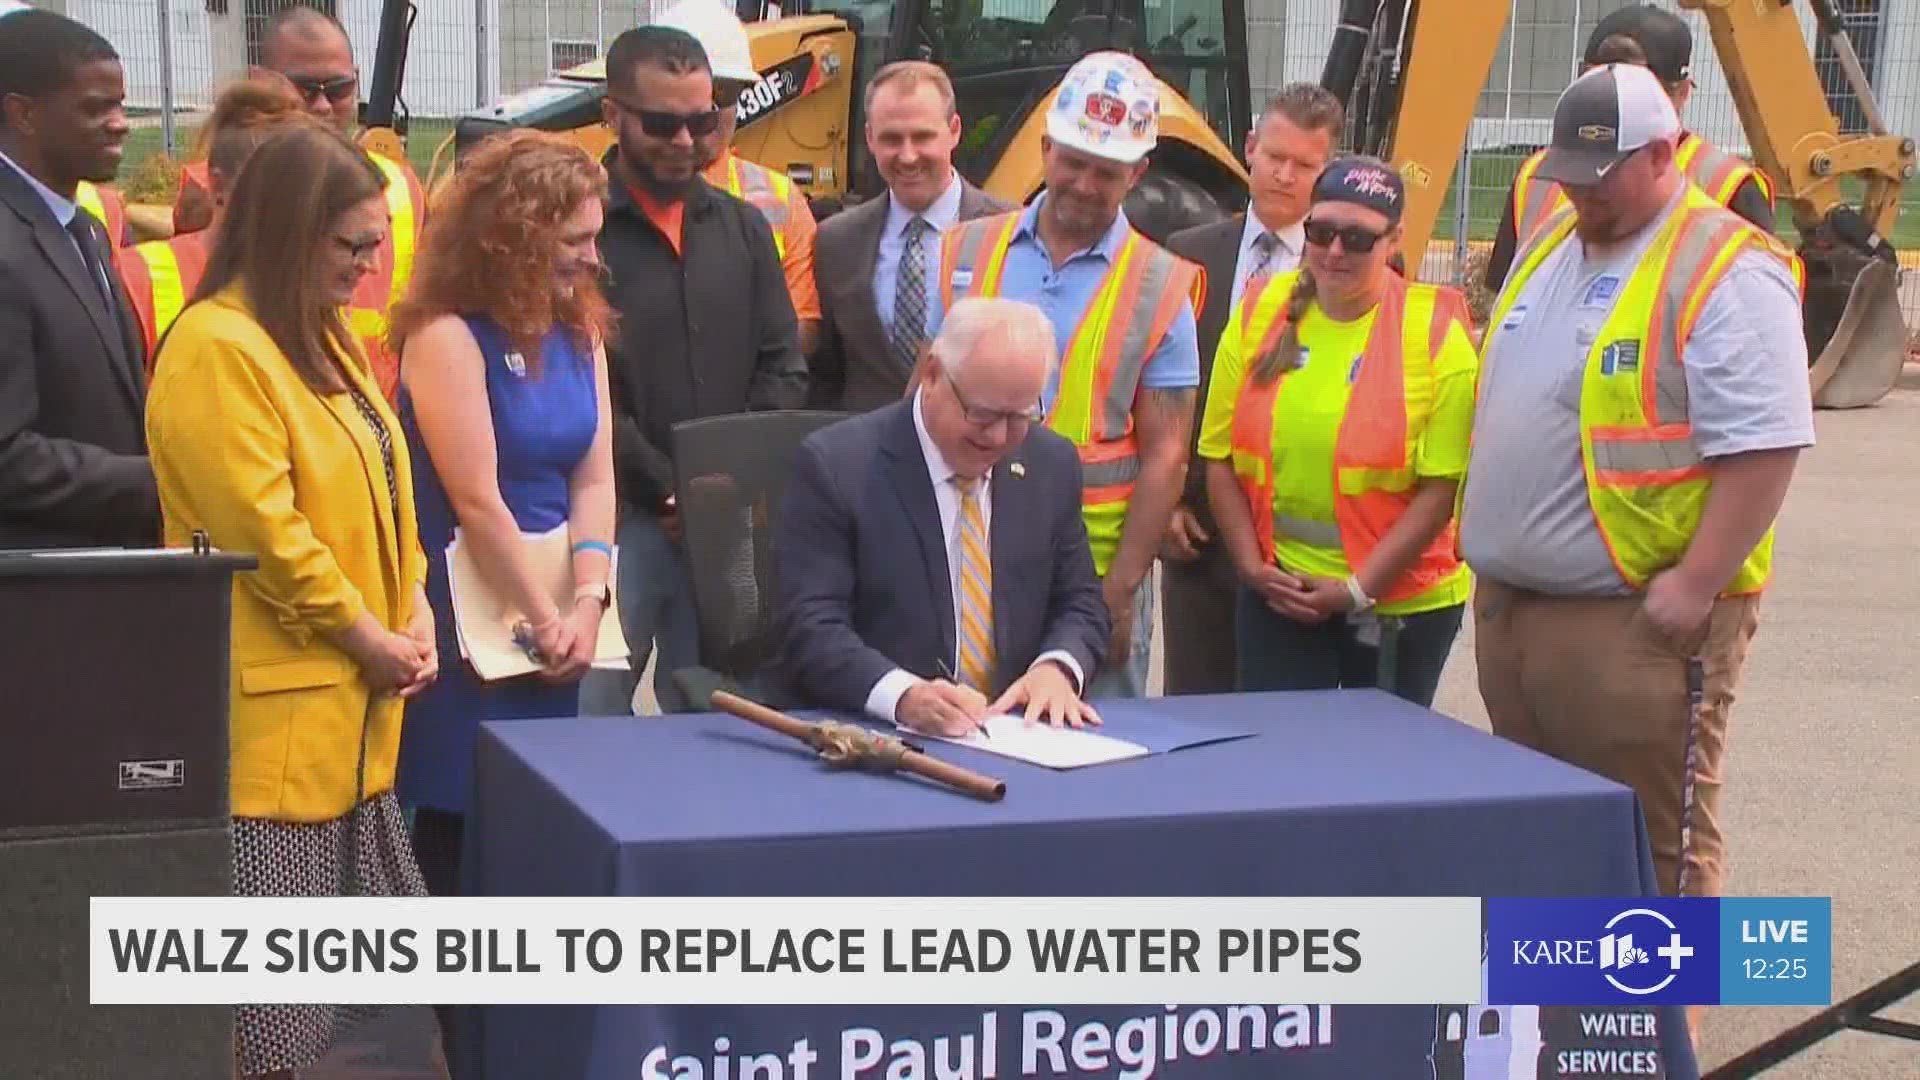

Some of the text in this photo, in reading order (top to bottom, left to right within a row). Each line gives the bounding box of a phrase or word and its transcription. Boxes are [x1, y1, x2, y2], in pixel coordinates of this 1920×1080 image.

[1580, 1013, 1657, 1037] WATER
[841, 1010, 997, 1080] Paul
[1022, 1004, 1332, 1080] Regional
[1557, 1051, 1657, 1075] SERVICES
